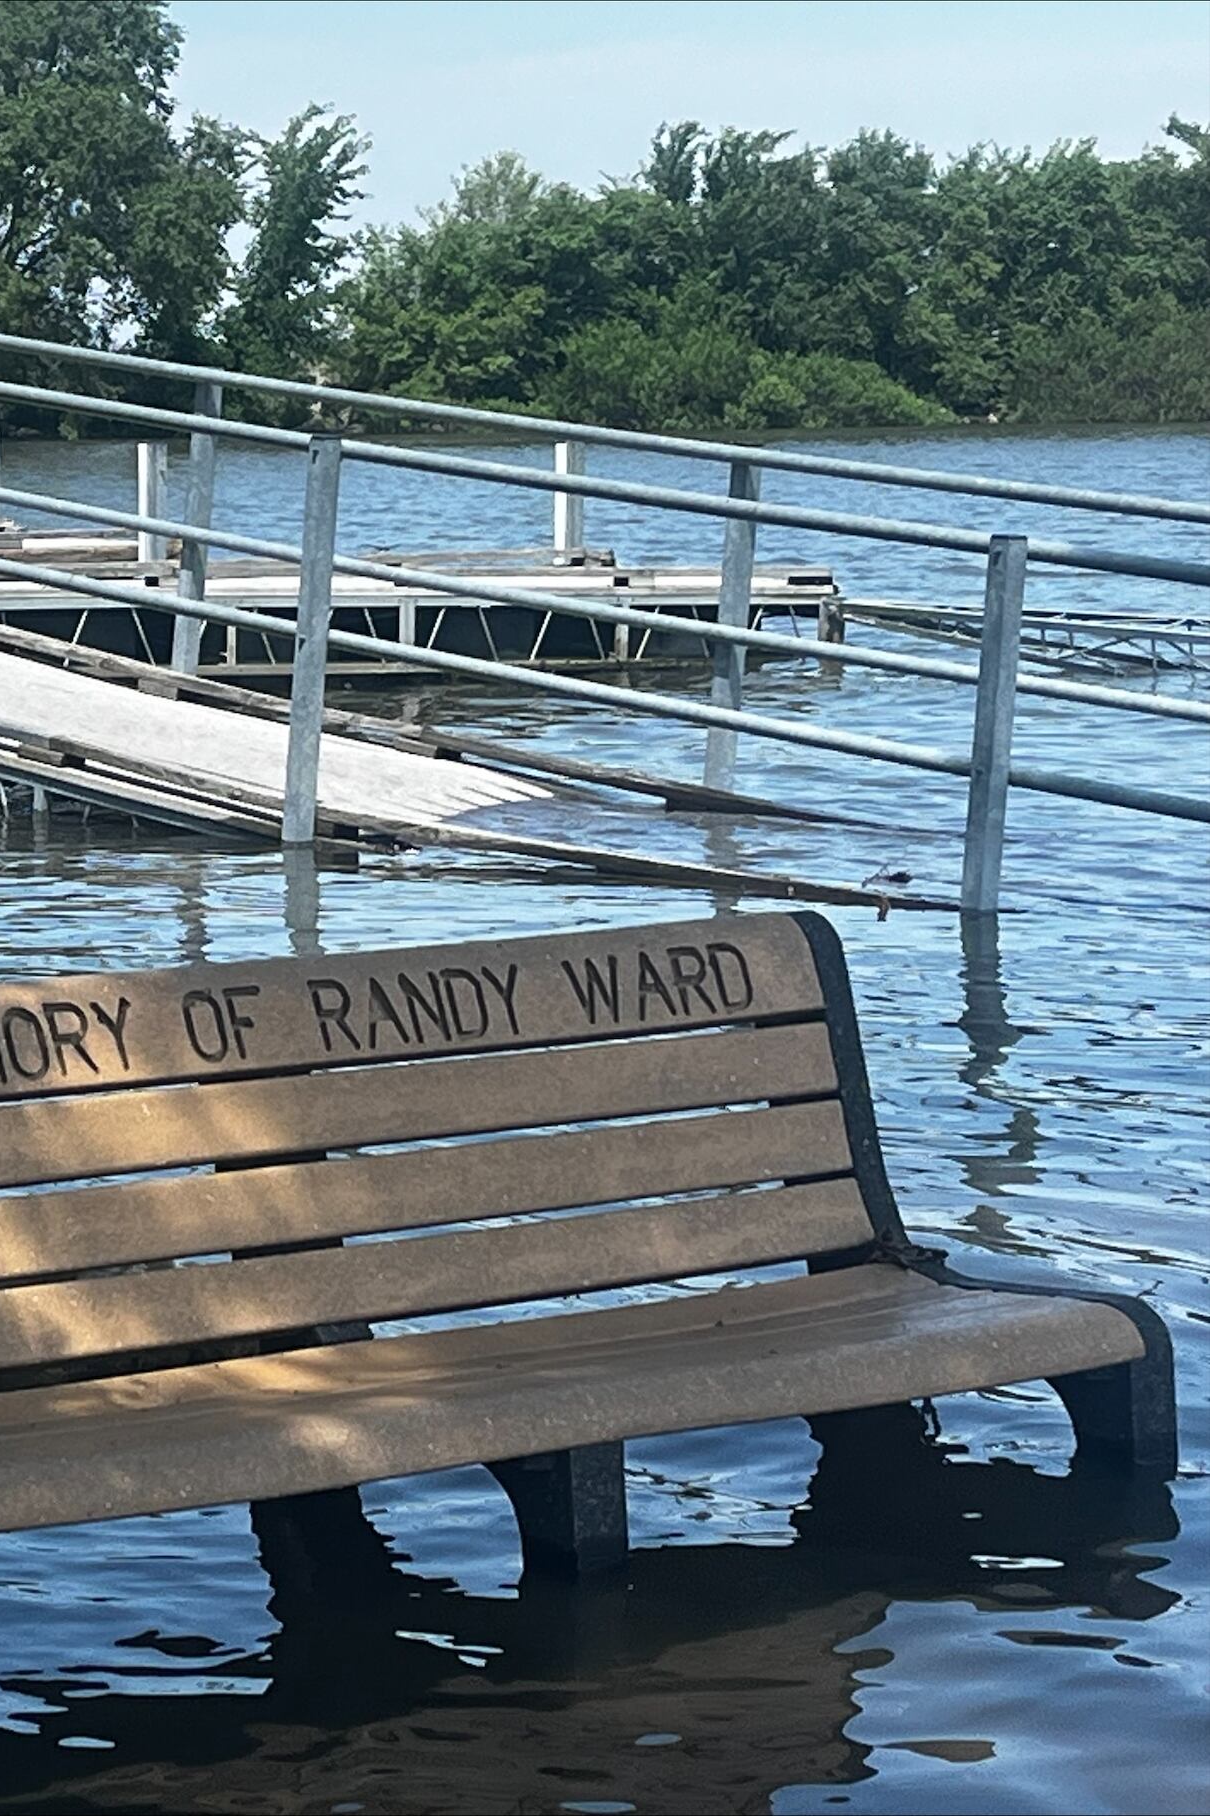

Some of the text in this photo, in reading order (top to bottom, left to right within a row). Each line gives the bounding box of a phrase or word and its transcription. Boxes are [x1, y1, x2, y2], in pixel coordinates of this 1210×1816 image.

[182, 986, 260, 1062] OF
[308, 963, 519, 1052] RANDY
[562, 942, 752, 1024] WARD
